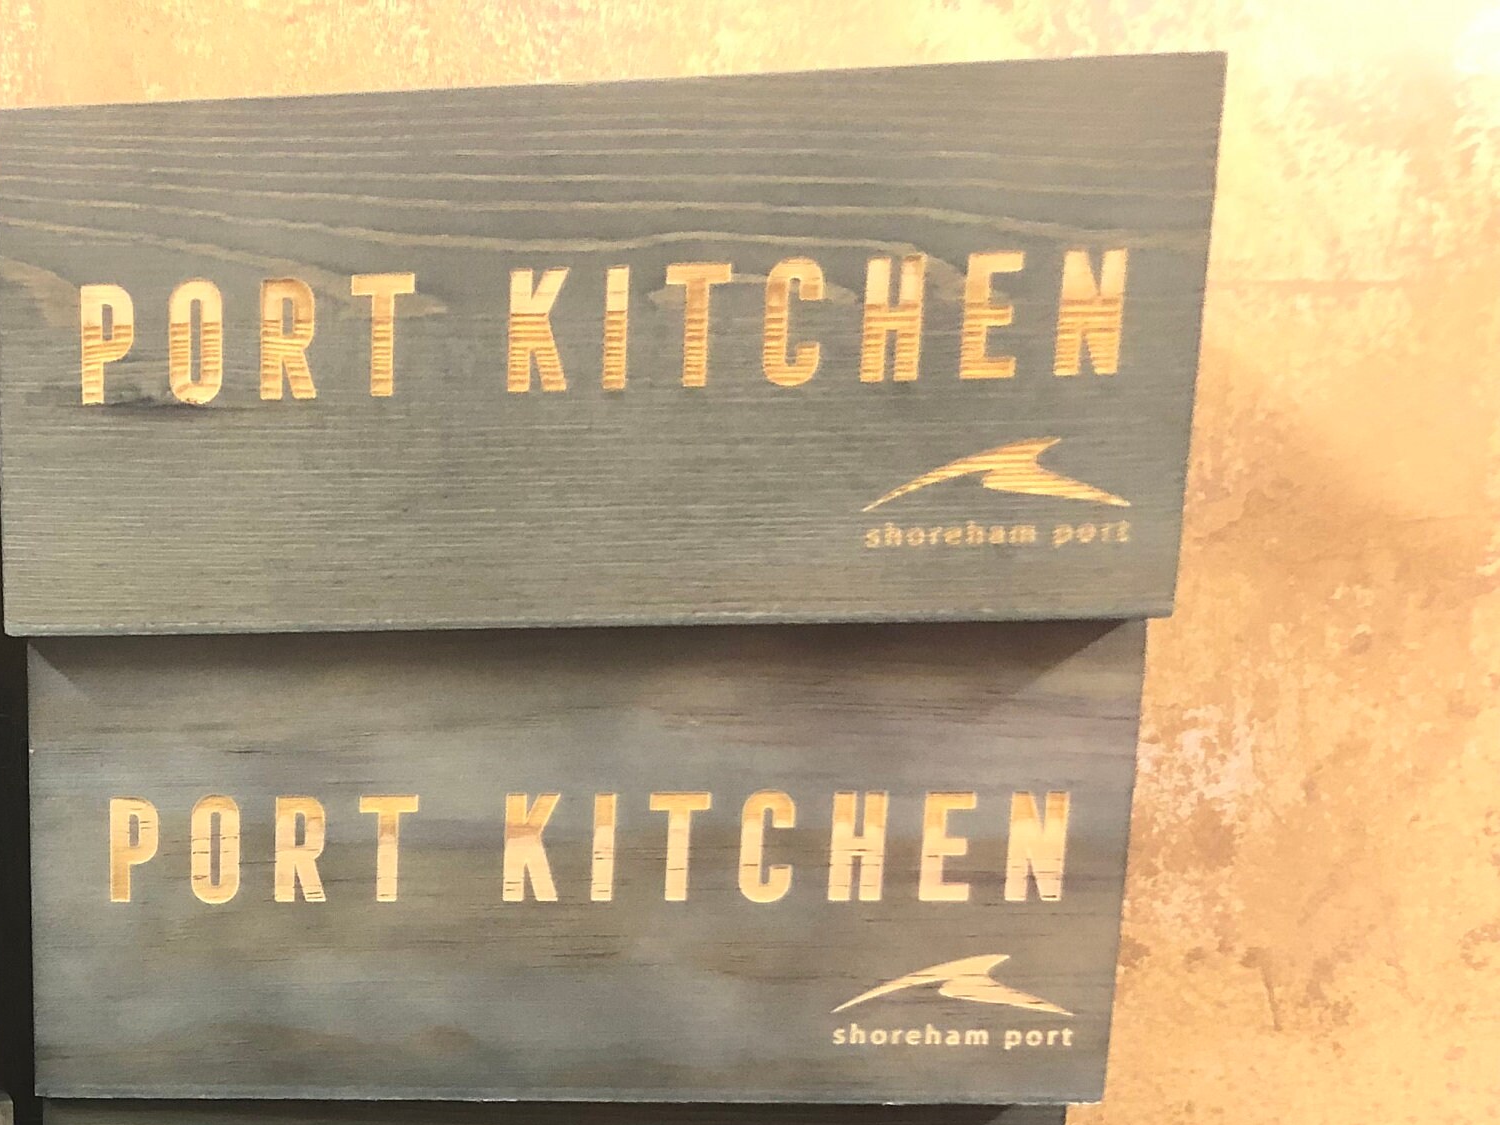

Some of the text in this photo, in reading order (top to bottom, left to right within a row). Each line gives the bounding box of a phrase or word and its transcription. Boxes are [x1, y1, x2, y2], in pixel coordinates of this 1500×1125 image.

[81, 248, 1128, 406] PORT KITCHEN
[865, 520, 1130, 548] shoreham port
[109, 790, 1071, 905] PORT KITCHEN
[832, 1023, 1074, 1049] shoreham port
